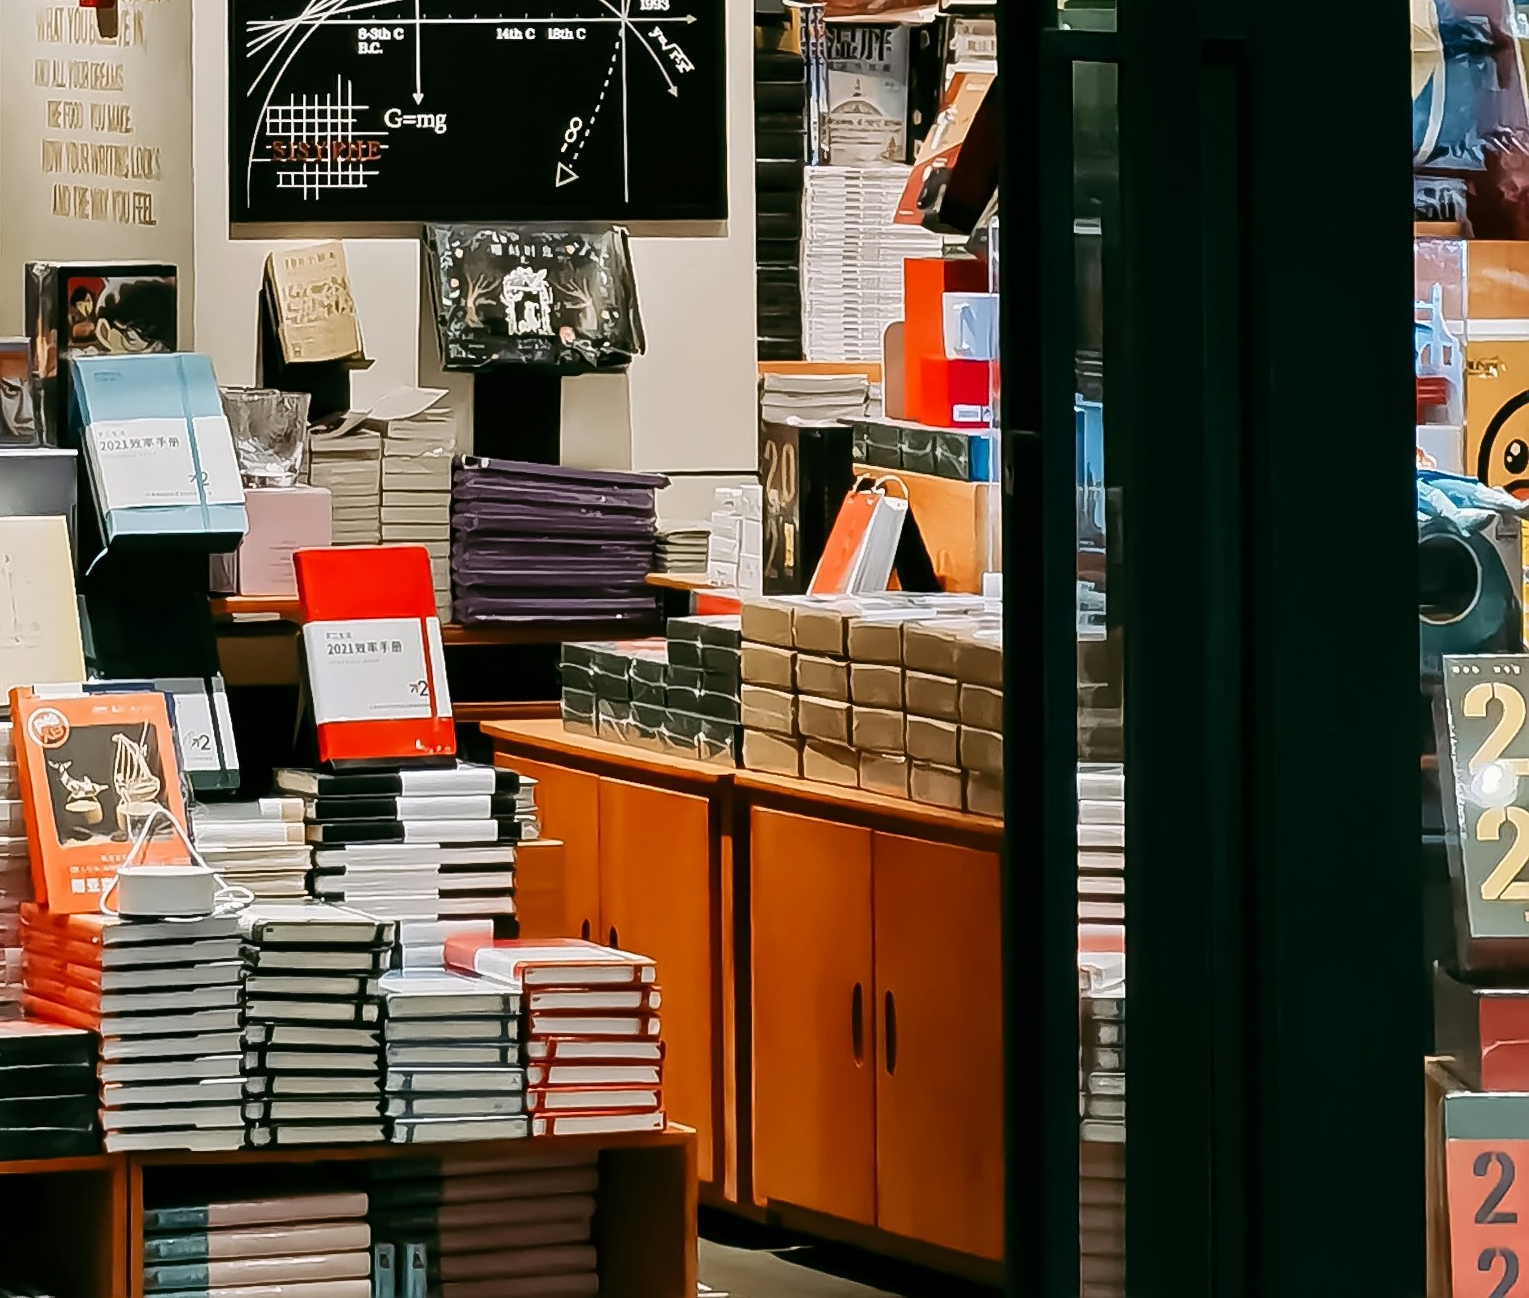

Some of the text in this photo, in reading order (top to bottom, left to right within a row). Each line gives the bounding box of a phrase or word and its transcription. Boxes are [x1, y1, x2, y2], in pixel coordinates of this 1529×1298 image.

[393, 27, 405, 40] C
[496, 28, 536, 40] 14th C
[576, 28, 587, 40] C
[357, 41, 384, 55] B.C.
[383, 107, 448, 135] G=mg
[271, 140, 382, 162] SISYPHE
